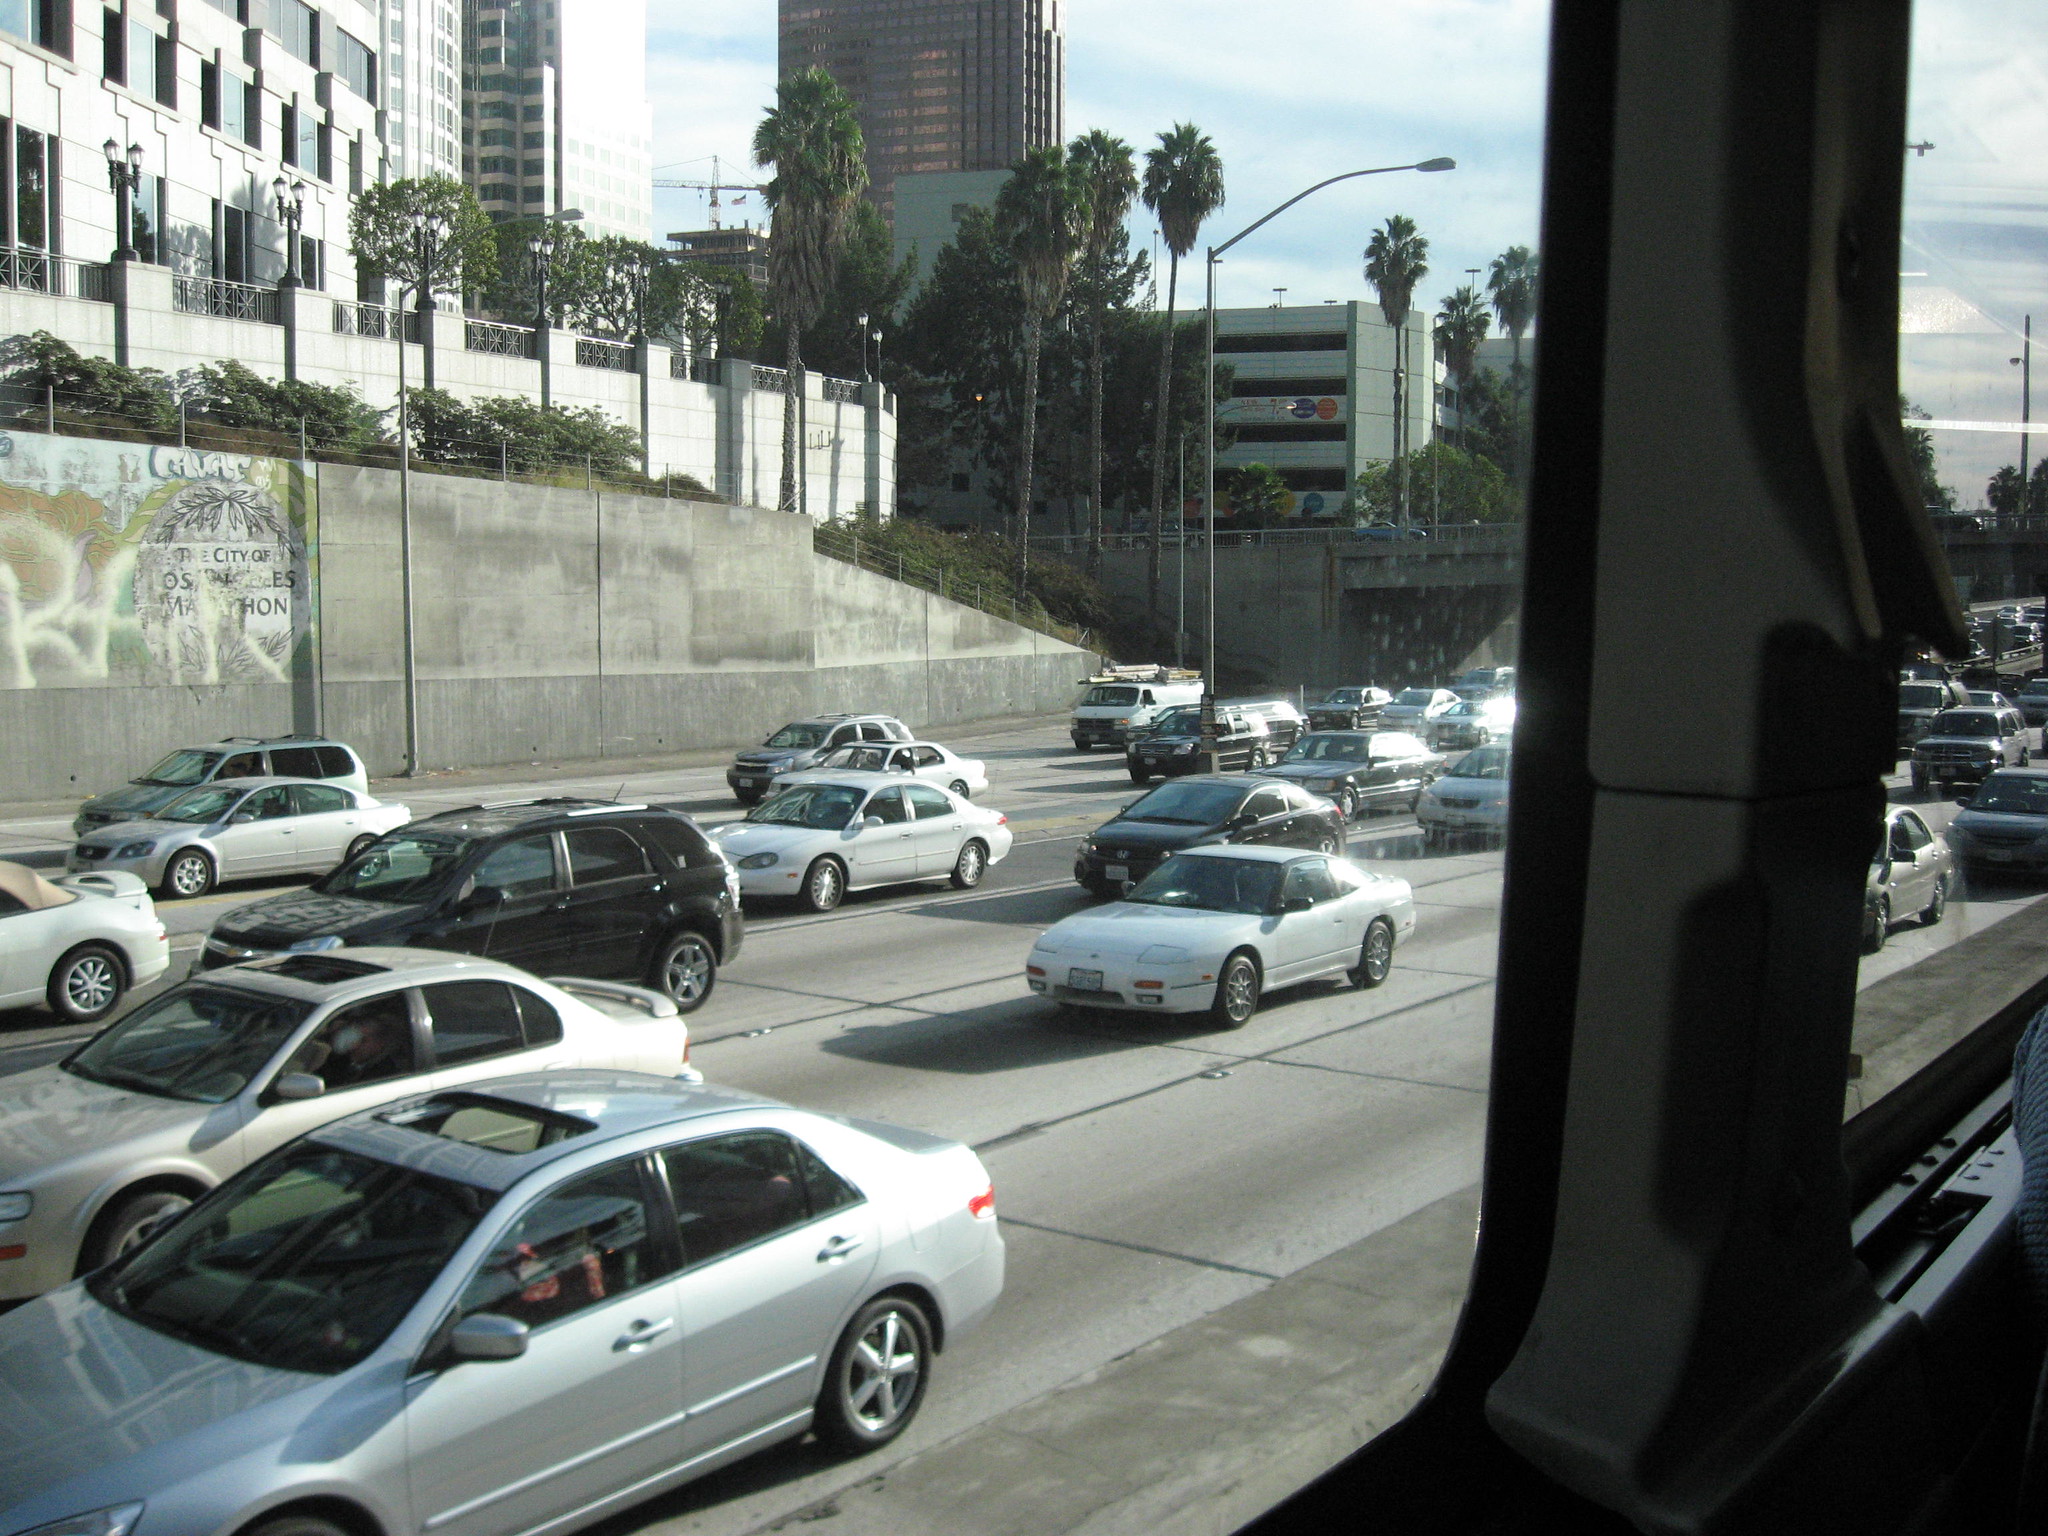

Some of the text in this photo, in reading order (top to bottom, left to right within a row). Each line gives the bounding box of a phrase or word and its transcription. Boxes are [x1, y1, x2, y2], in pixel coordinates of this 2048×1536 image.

[213, 547, 249, 563] CITY
[251, 549, 271, 563] OF
[160, 571, 194, 590] OS
[160, 595, 288, 616] MAHON
